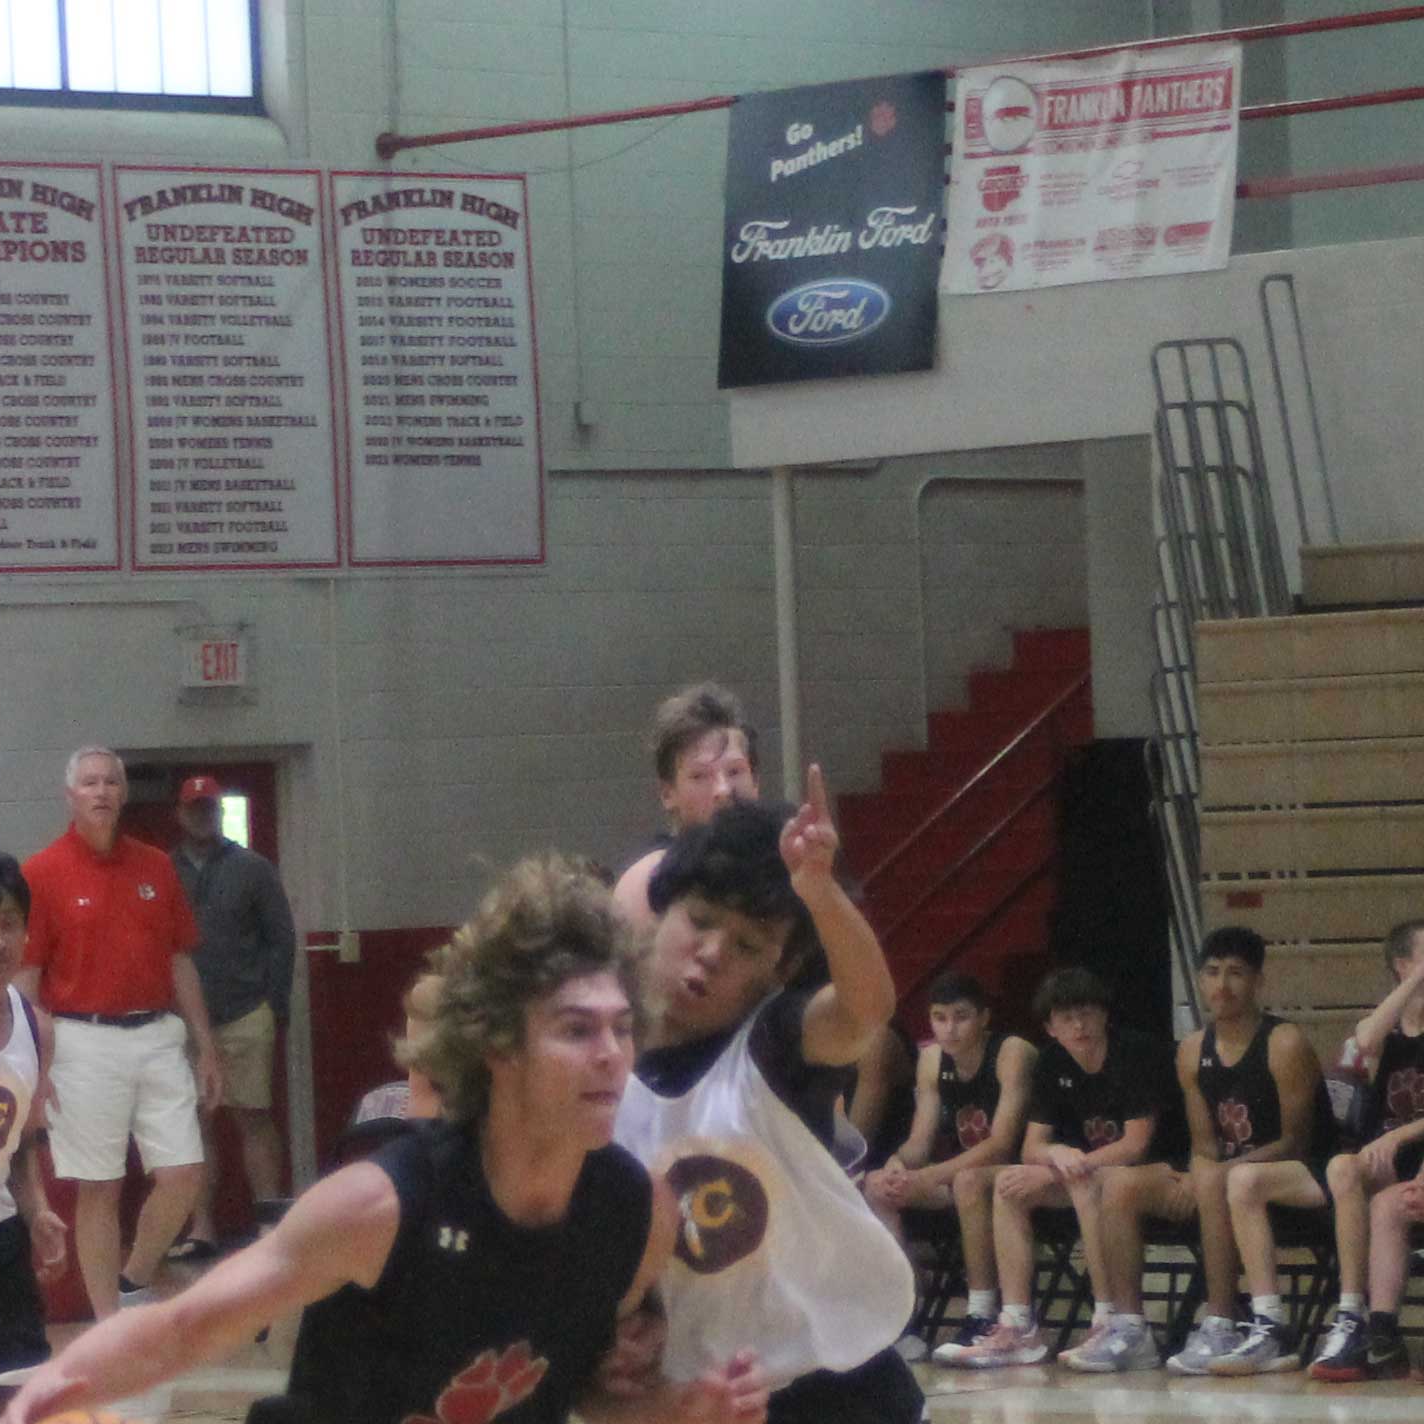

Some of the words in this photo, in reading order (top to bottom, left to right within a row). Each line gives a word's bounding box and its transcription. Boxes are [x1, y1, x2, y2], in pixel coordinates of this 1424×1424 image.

[1130, 76, 1226, 114] PANTHERS
[786, 122, 814, 145] Go
[770, 124, 864, 183] Panthers!
[30, 182, 96, 222] HIGH
[124, 183, 245, 222] FRANKLIN
[250, 188, 315, 226] HIGH
[339, 188, 455, 227] FRANKLIN
[460, 192, 520, 230] HIGH
[146, 223, 296, 245] UNDEFEATED
[361, 227, 503, 248] UNDEFEATED
[731, 219, 853, 264] Franklin
[858, 205, 936, 250] Ford
[134, 246, 227, 265] REGULAR
[232, 247, 310, 267] SEASON
[351, 249, 438, 268] REGULAR
[443, 250, 515, 269] SEASON
[787, 289, 869, 335] Ford
